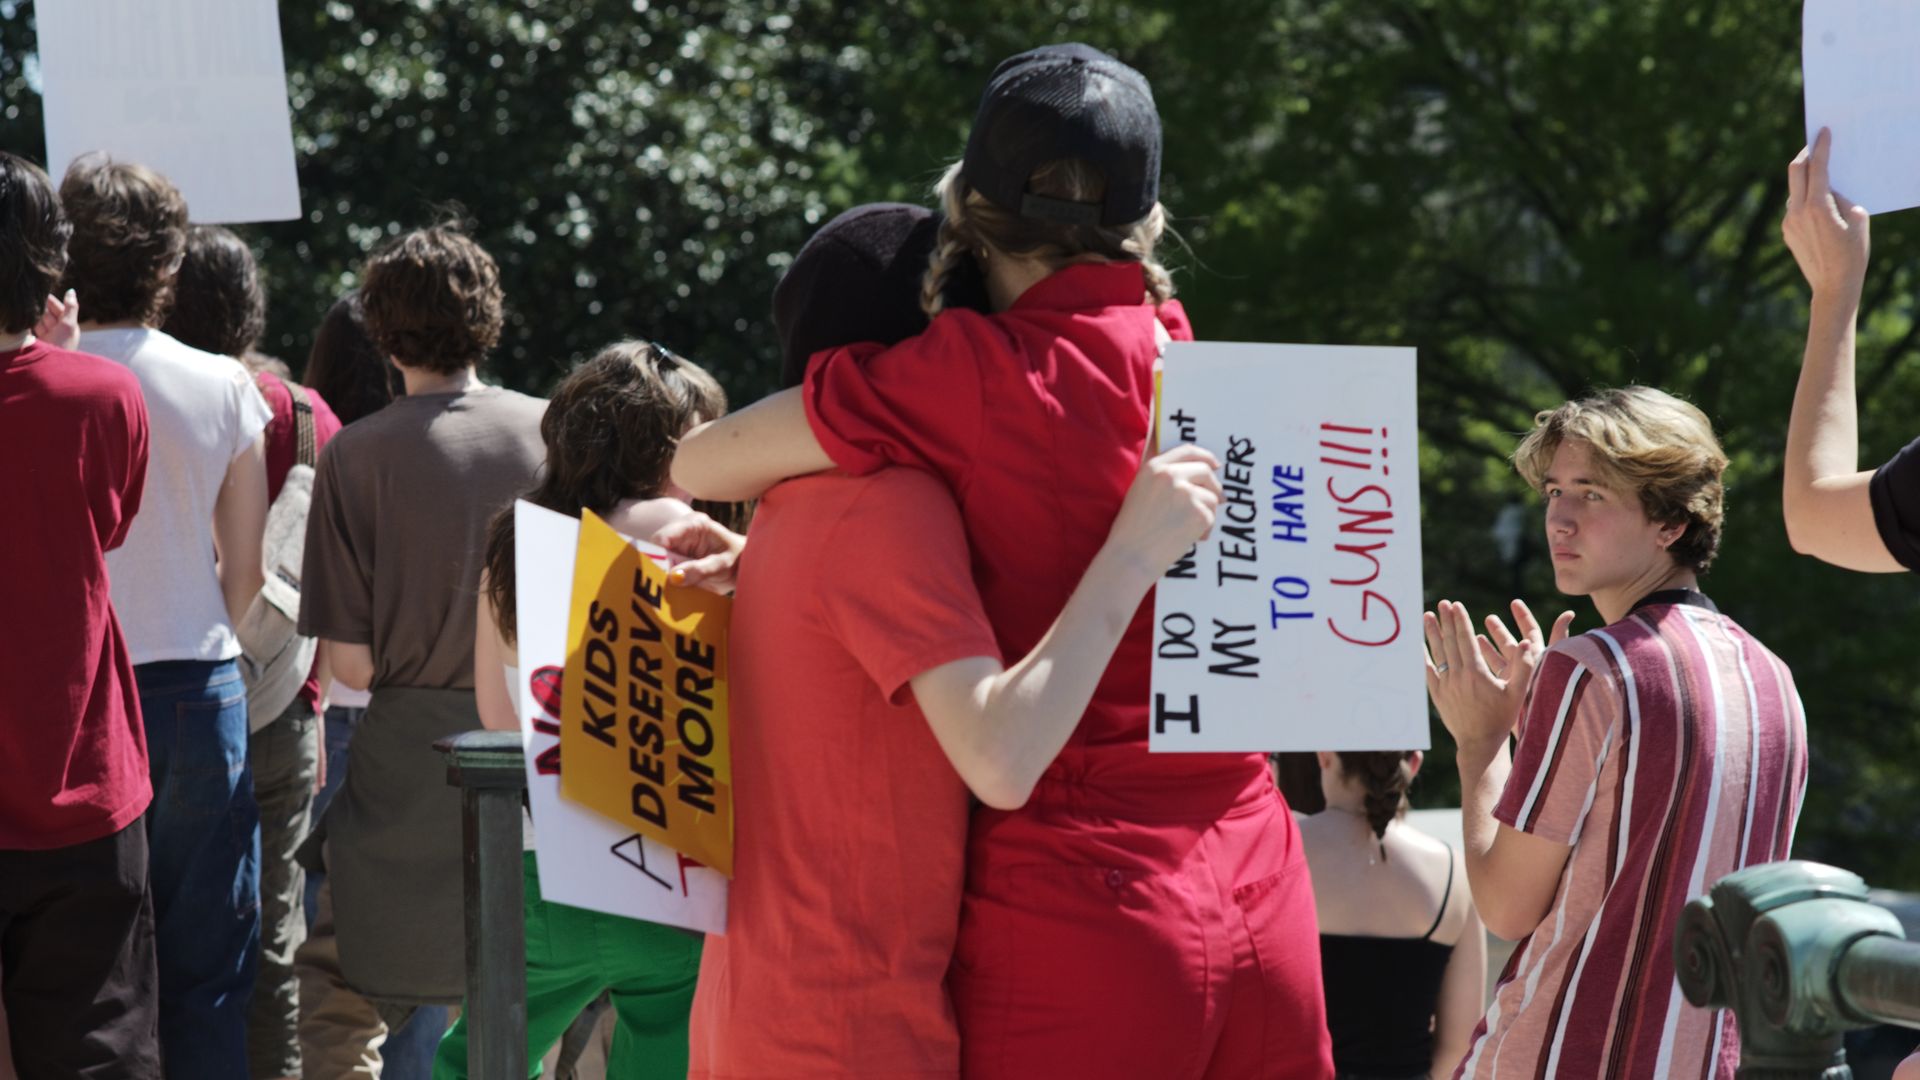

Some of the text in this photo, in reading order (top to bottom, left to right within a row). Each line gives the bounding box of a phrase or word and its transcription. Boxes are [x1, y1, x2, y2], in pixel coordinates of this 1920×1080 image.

[1208, 435, 1260, 678] MY TEACHERS
[1269, 464, 1315, 630] TO HAVE
[1320, 422, 1401, 647] GUNS!!!
[581, 600, 620, 749] KIDS
[628, 567, 668, 830] DESERVE
[1155, 692, 1201, 734] I
[1158, 612, 1199, 659] DO
[674, 633, 717, 815] MORE
